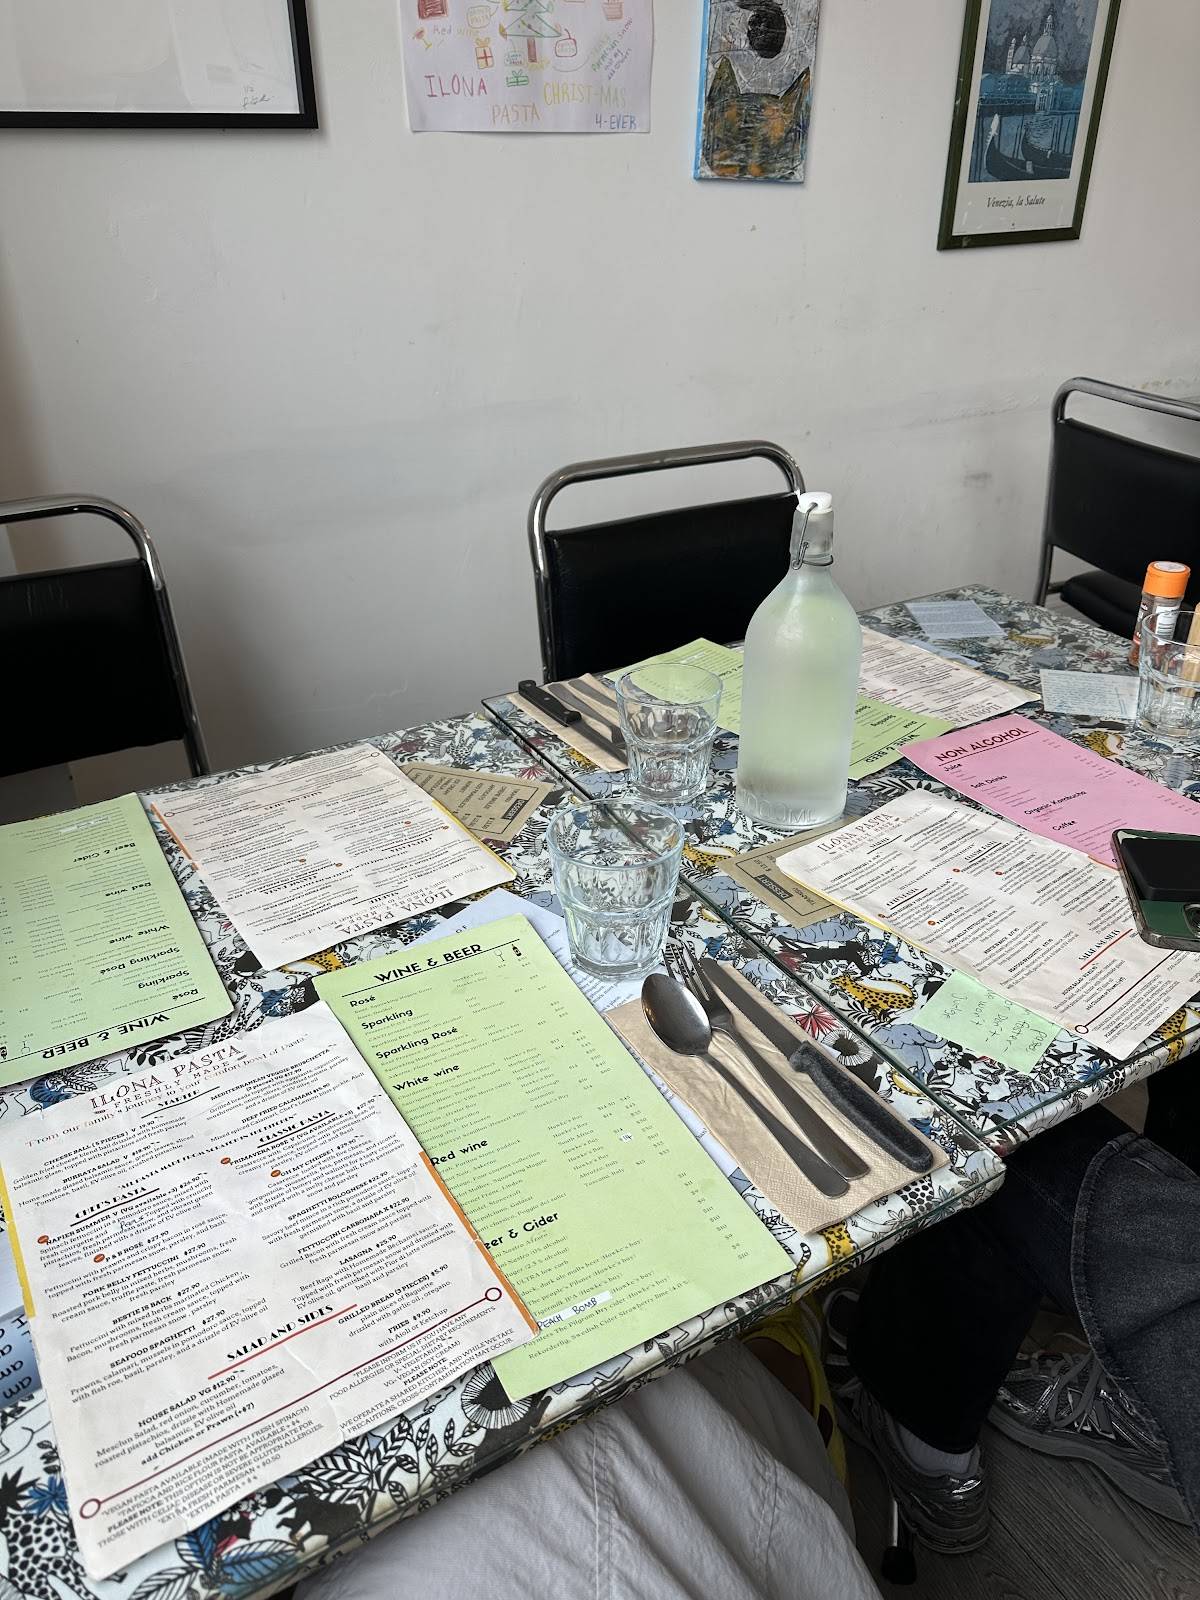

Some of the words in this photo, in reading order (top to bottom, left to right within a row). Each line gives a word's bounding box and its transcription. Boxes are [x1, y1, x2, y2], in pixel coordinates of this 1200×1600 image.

[424, 74, 488, 98] ILONA
[491, 104, 541, 124] PASTA
[595, 113, 637, 130] 4-EVER
[987, 196, 1014, 208] Venezia,
[1016, 196, 1022, 206] la
[1024, 194, 1046, 206] Salute
[934, 744, 968, 763] NON
[968, 727, 1029, 751] ALCOHOL
[944, 762, 962, 772] Juice
[970, 779, 986, 788] Soft
[1024, 802, 1050, 816] Organic
[817, 832, 857, 852] ILONA
[855, 813, 894, 833] PASTA
[1052, 820, 1078, 832] Coffee
[757, 874, 788, 898] DESSERT
[400, 889, 454, 912] ILONA
[136, 924, 170, 936] White
[340, 911, 396, 935] PASTA
[109, 935, 133, 944] wine
[130, 947, 180, 966] Sparkling
[373, 962, 421, 982] WINE
[426, 957, 437, 966] &
[442, 944, 481, 963] BEER
[138, 970, 190, 990] Sparkling
[349, 995, 375, 1007] Rosé
[119, 1014, 170, 1035] WINE
[361, 1009, 412, 1029] Sparkling
[42, 1039, 90, 1060] BEER
[375, 1038, 428, 1058] Sparkling
[431, 1026, 457, 1039] Rosé
[90, 1075, 161, 1108] ILONA
[172, 1045, 240, 1077] PASTA
[114, 1079, 179, 1108] FRESHLY
[193, 1061, 229, 1078] MADE
[392, 1076, 428, 1090] White
[433, 1065, 459, 1076] wine
[258, 1105, 277, 1115] FRIED
[278, 1091, 312, 1107] CALAMARI
[97, 1158, 119, 1169] SALAD
[428, 1150, 455, 1167] Red
[459, 1140, 487, 1153] wine
[292, 1163, 303, 1171] MY
[287, 1199, 327, 1220] SPAGHETTI
[327, 1181, 368, 1201] BOLOGNESE
[368, 1171, 387, 1183] $22.90
[75, 1214, 110, 1233] SUMMER
[297, 1230, 340, 1253] FETTUCCINI
[340, 1210, 383, 1232] CARBONARA
[389, 1197, 409, 1208] $22.90
[481, 1236, 502, 1251] eer
[508, 1228, 518, 1238] &
[522, 1213, 557, 1231] Cider
[147, 1230, 168, 1243] $27.90
[339, 1247, 372, 1264] LASAGNA
[375, 1234, 396, 1248] $25.90
[82, 1285, 105, 1298] PORK
[106, 1275, 130, 1288] BELLY
[132, 1255, 178, 1277] FETTUCCINI
[184, 1242, 205, 1255] $27.90
[112, 1308, 140, 1324] BESTIE
[150, 1295, 171, 1307] BACK
[177, 1282, 199, 1296] $27.90
[338, 1305, 369, 1324] GRILLED
[370, 1292, 394, 1307] BREAD
[401, 1274, 429, 1291] PIECES)
[430, 1263, 448, 1276] $5.90
[388, 1319, 409, 1333] FRIES
[412, 1308, 430, 1320] $9.90
[537, 1314, 563, 1329] PEACH
[571, 1297, 596, 1314] BOMB
[110, 1347, 148, 1368] SEAFOOD
[149, 1325, 195, 1350] SPAGHETTI
[202, 1309, 225, 1325] $27.90
[227, 1337, 266, 1359] SALAD
[270, 1323, 295, 1340] AND
[297, 1305, 332, 1323] SIDES
[2, 1375, 33, 1400] am
[138, 1408, 168, 1427] HOUSE
[169, 1394, 196, 1411] SALAD
[198, 1387, 211, 1395] VG
[212, 1375, 235, 1390] $12.90
[141, 1452, 157, 1464] add
[158, 1434, 194, 1455] Chicken
[206, 1414, 233, 1430] Prawn
[234, 1402, 254, 1416] (+$7)
